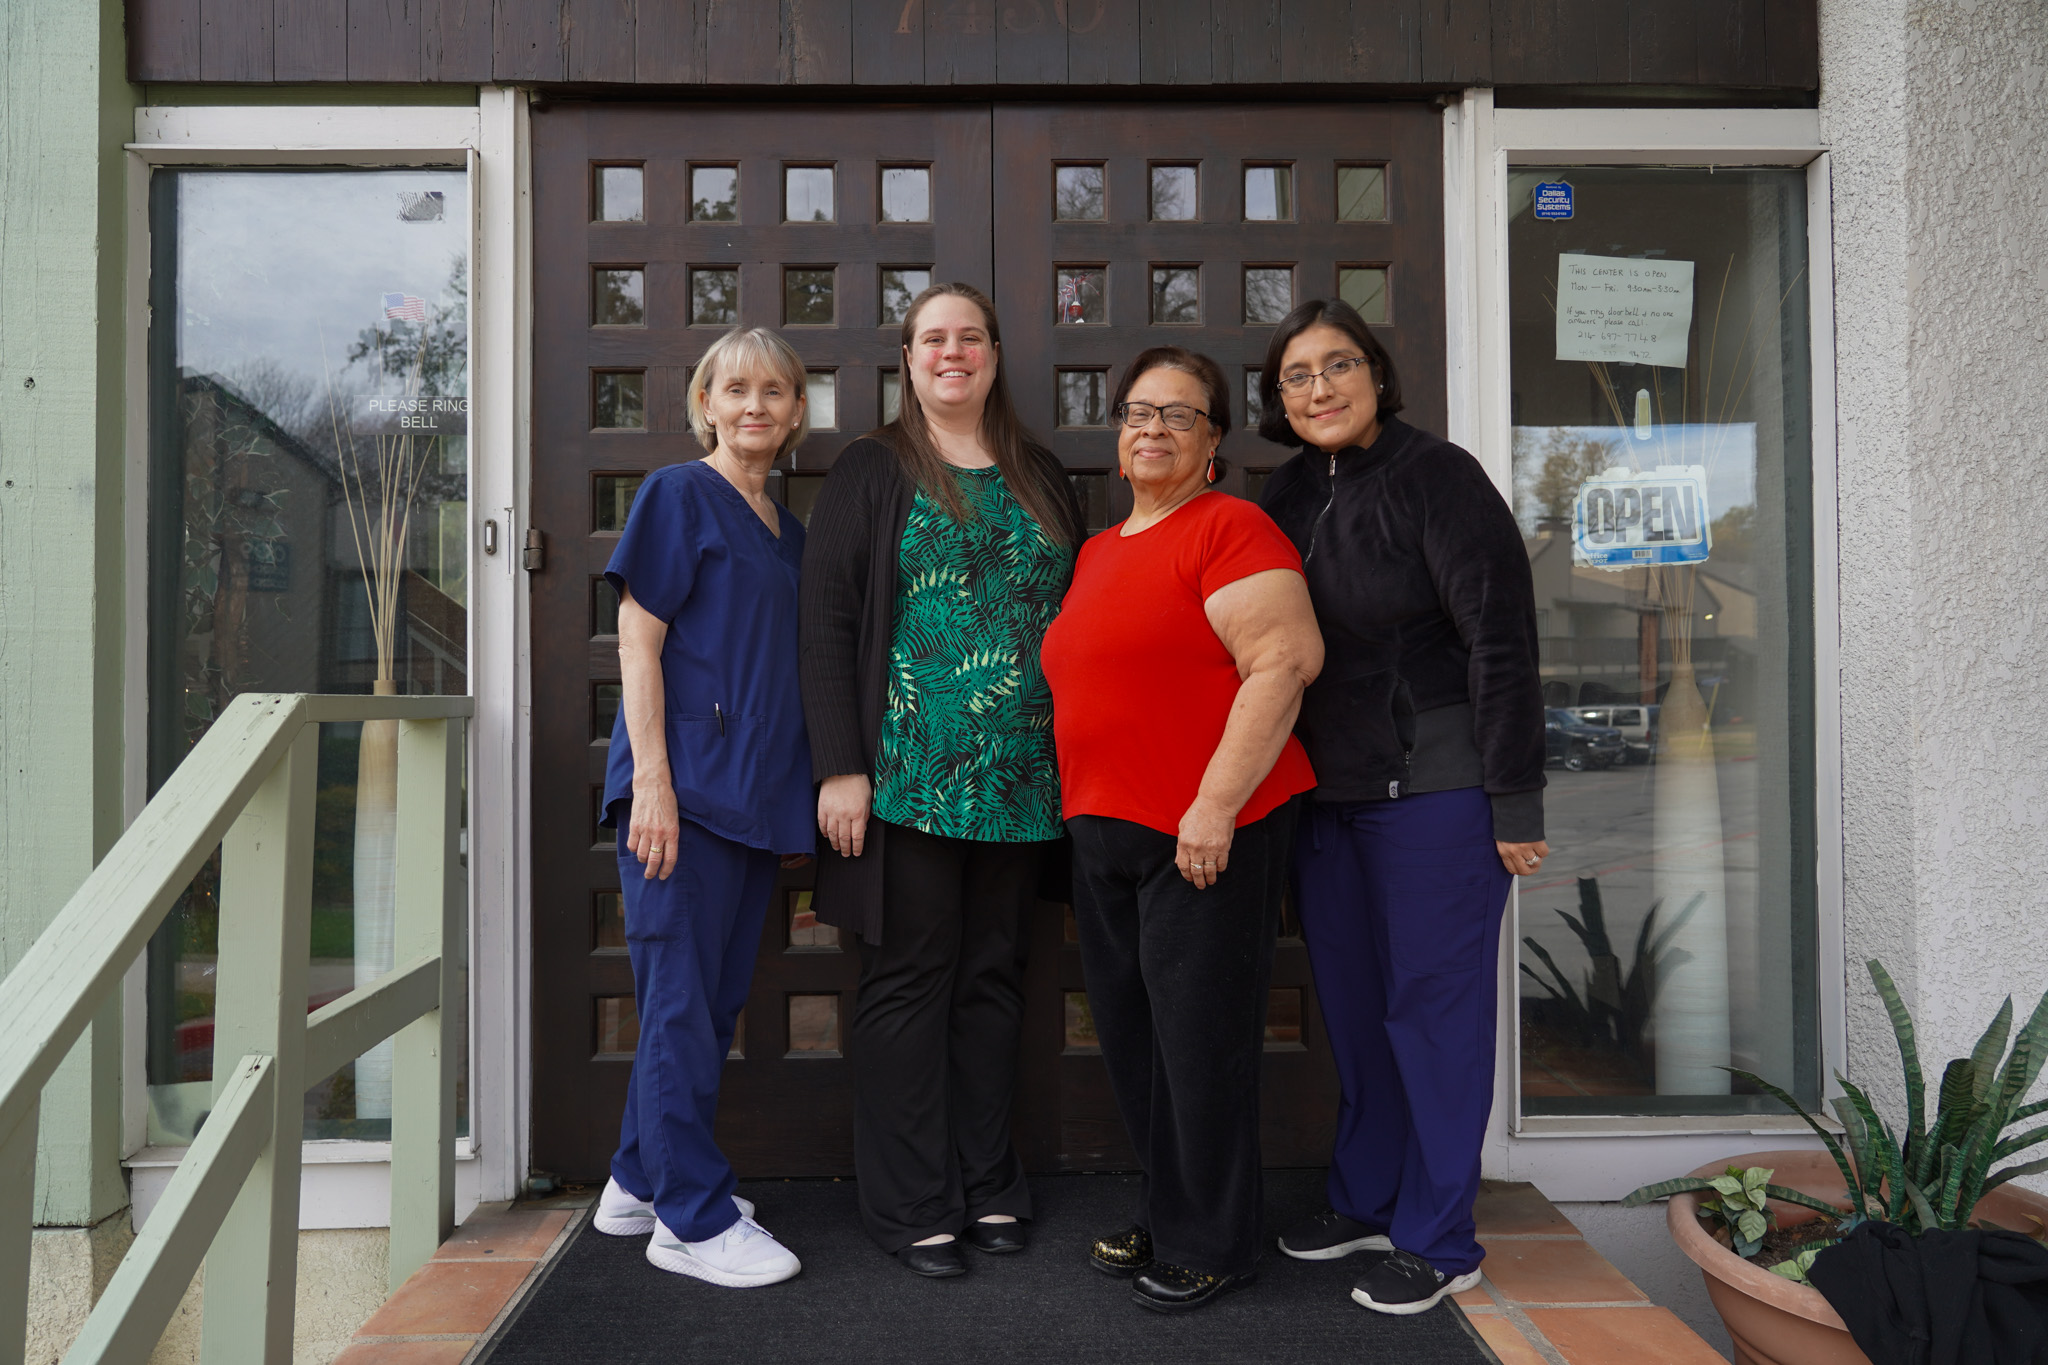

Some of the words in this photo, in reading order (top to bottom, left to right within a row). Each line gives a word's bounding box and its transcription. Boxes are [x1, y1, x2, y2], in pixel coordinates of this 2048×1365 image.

[1537, 203, 1571, 211] Systems
[1568, 264, 1586, 276] THIS
[1592, 268, 1624, 277] CENTER
[1629, 268, 1639, 277] IS
[1566, 307, 1573, 315] If
[1574, 309, 1586, 318] you
[1590, 309, 1605, 319] ring
[1604, 318, 1624, 328] please
[369, 400, 428, 412] PLEASE
[432, 400, 468, 412] RING
[401, 416, 438, 428] BELL
[1587, 486, 1698, 544] OPEN
